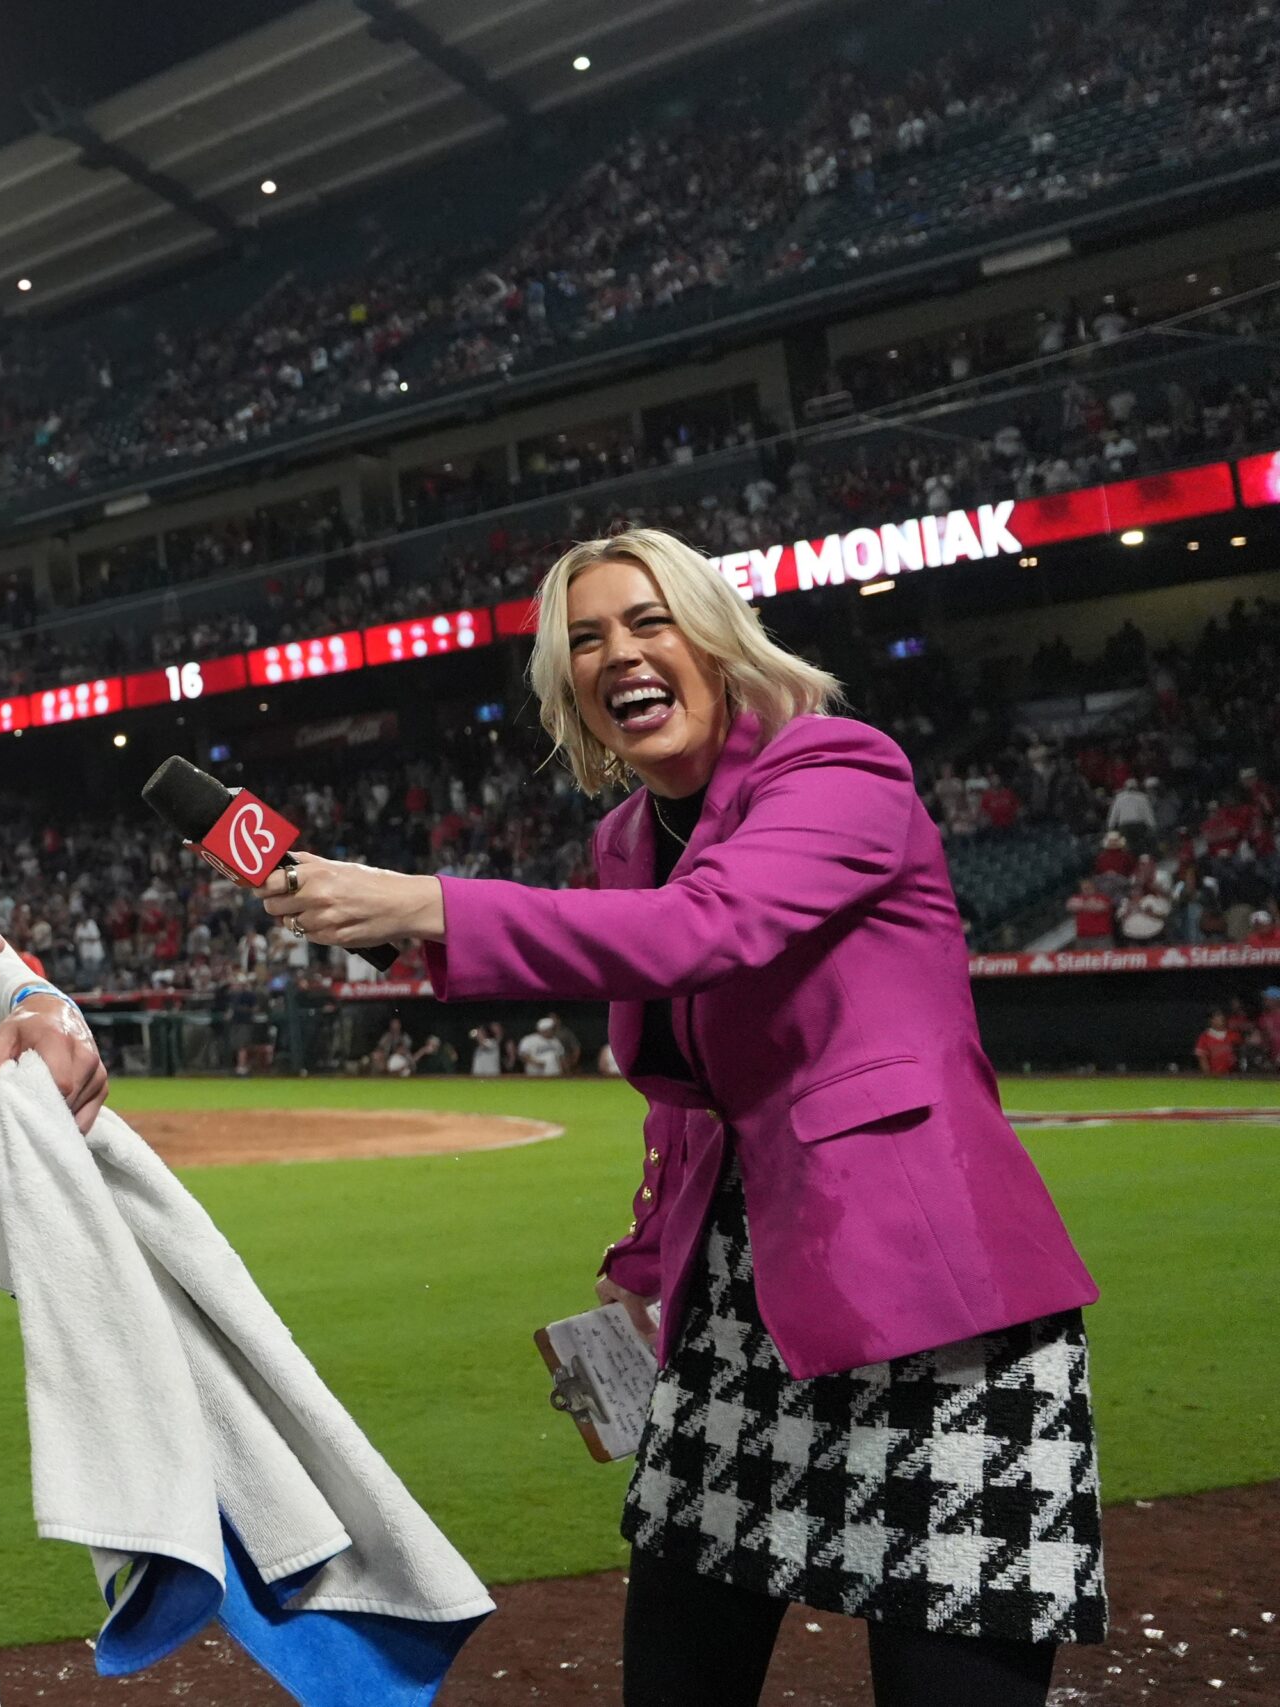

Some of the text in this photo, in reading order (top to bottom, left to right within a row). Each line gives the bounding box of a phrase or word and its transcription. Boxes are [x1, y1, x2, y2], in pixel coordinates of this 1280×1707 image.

[709, 499, 1023, 601] EY MONIAK
[165, 661, 204, 702] 16
[229, 802, 276, 875] B
